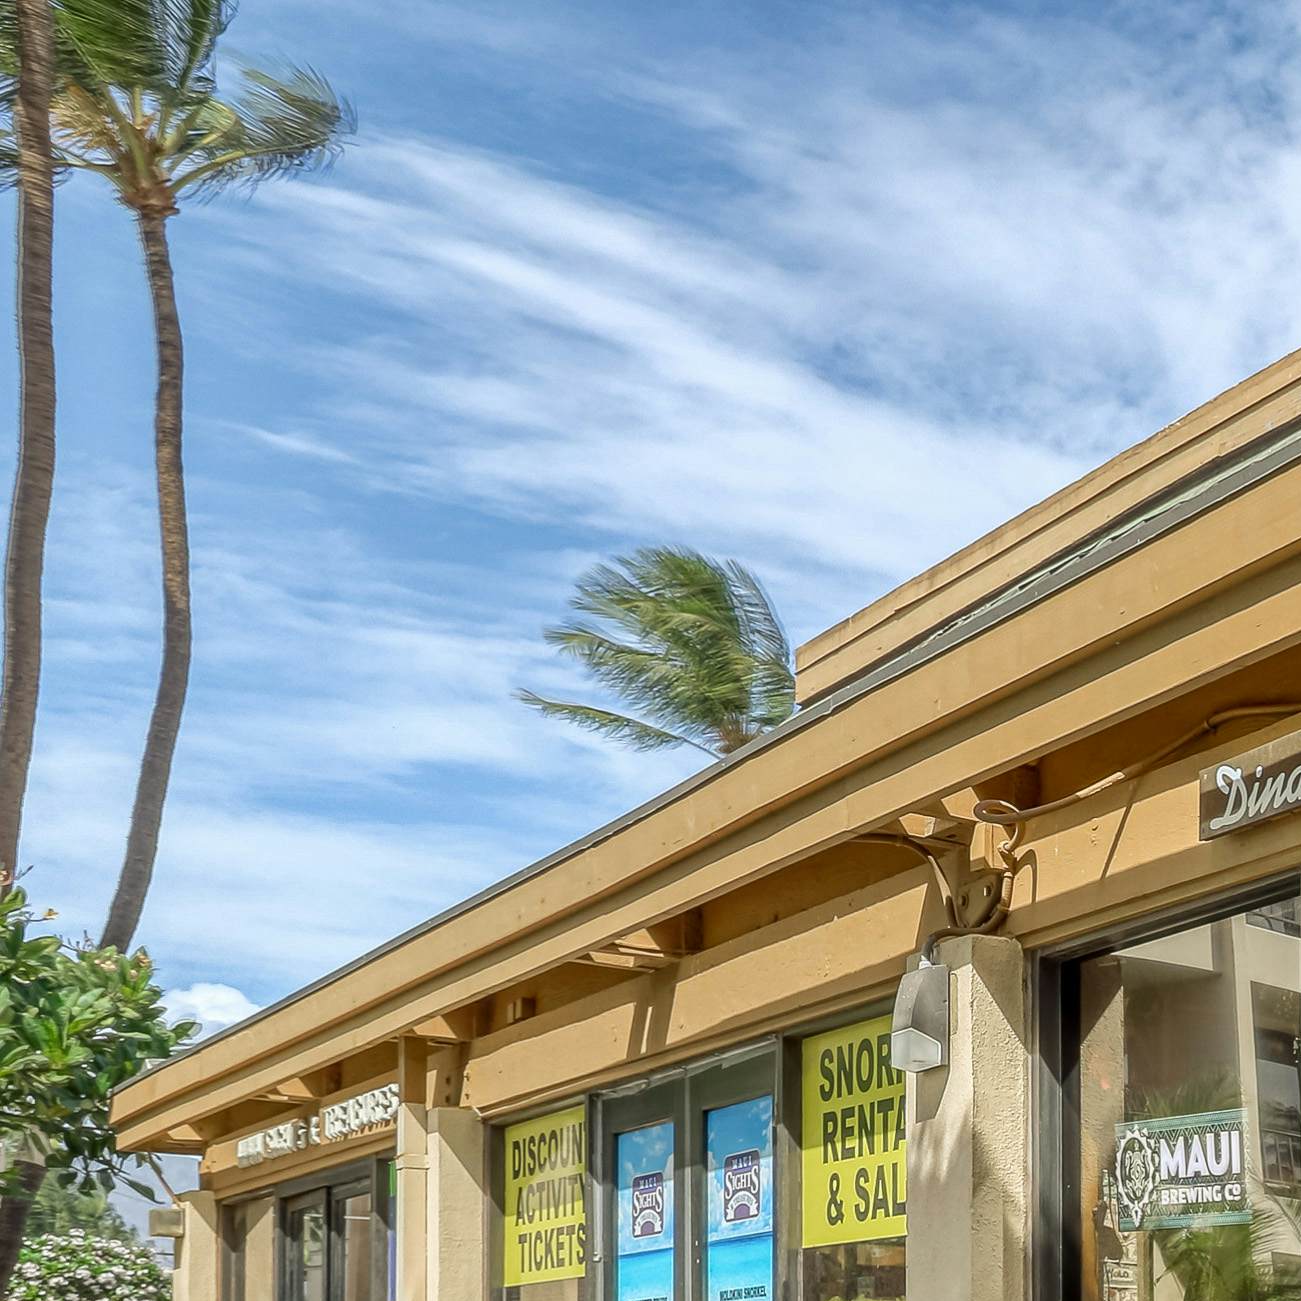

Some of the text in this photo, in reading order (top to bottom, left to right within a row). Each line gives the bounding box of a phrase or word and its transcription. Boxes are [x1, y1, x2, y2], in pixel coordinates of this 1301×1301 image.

[819, 1032, 905, 1102] SNOR
[512, 1122, 586, 1180] DISCOUN
[1160, 1130, 1240, 1180] MAUI
[633, 1186, 663, 1217] SIGHTS
[725, 1166, 759, 1200] SIGHTS
[827, 1172, 844, 1226] &
[1161, 1186, 1222, 1205] BREWING
[518, 1222, 587, 1274] TICKETS
[744, 1285, 767, 1300] SNORKEL
